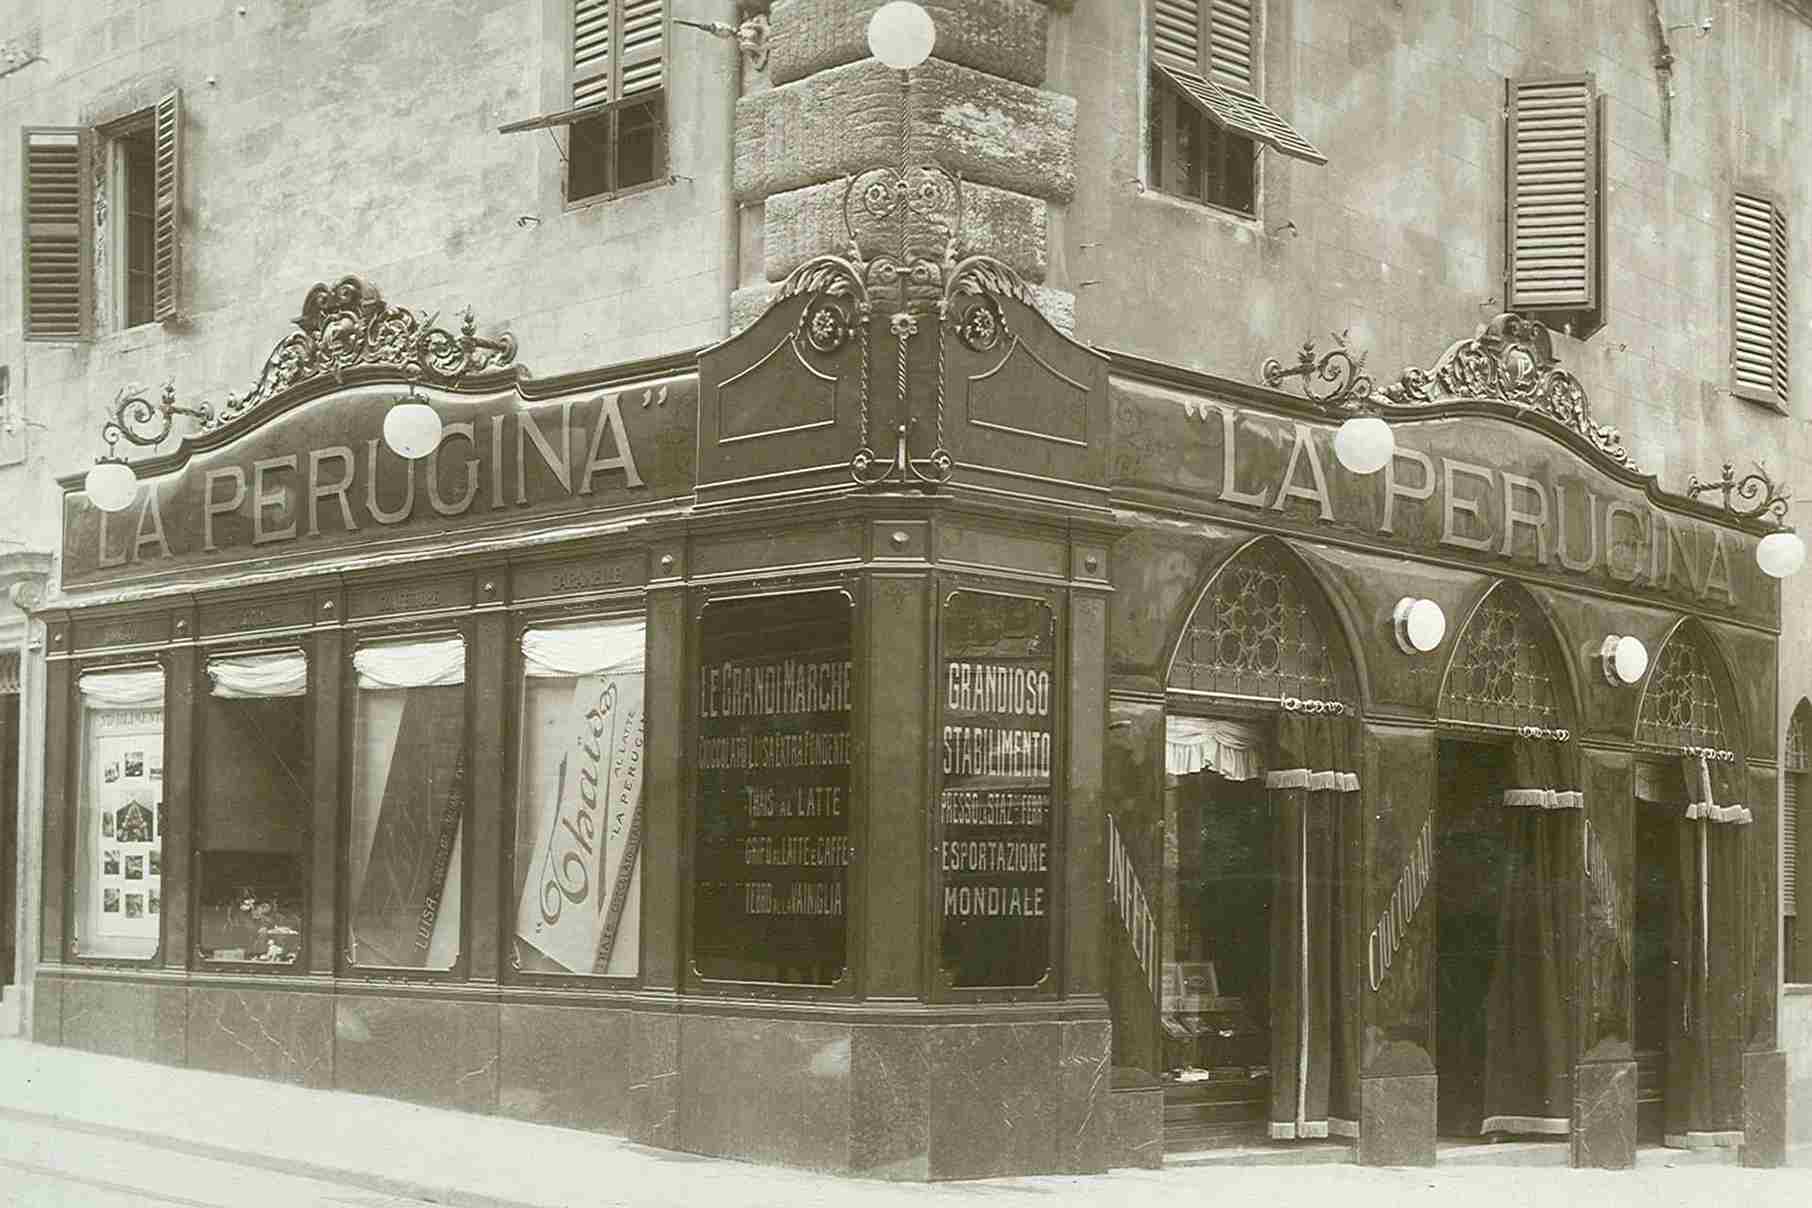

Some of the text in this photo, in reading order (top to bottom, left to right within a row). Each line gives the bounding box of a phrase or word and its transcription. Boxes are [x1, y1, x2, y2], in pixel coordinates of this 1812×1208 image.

[722, 661, 782, 716] GRANDI
[784, 658, 851, 712] MARCHE
[949, 662, 1049, 716] GRANDIOSO
[943, 725, 1050, 777] STABILIMENTO
[797, 786, 840, 816] LATTE
[941, 841, 1048, 872] ESPORTAZIONE
[944, 888, 1045, 916] MONDIALE
